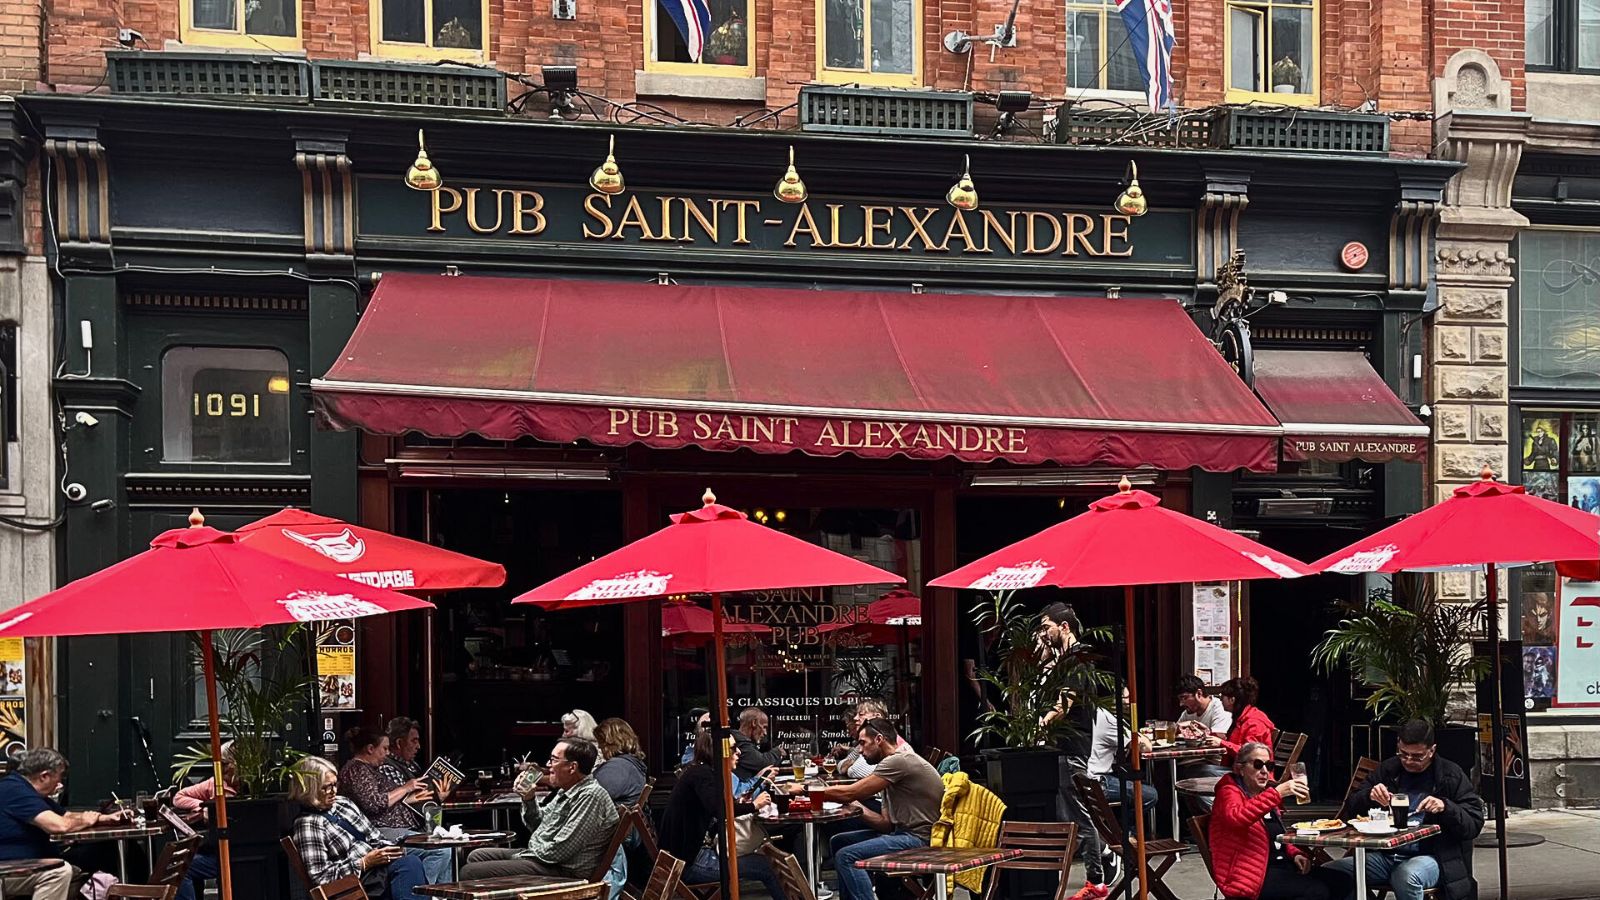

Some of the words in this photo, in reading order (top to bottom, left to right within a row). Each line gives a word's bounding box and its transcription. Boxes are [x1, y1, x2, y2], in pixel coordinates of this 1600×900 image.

[427, 187, 547, 234] PUB
[582, 193, 1133, 257] SAINT-ALEXANDRE
[194, 393, 259, 417] 1091
[607, 408, 679, 438] PUB
[693, 413, 798, 444] SAINT
[815, 420, 1029, 454] ALEXANDRE
[1296, 441, 1315, 451] PUB
[1319, 442, 1350, 452] SAINT
[1353, 443, 1416, 453] ALEXANDRE
[993, 573, 1037, 581] STELLA
[596, 582, 655, 591] STELLA
[591, 590, 647, 598] ARTOIS
[298, 600, 357, 612] STELLA
[310, 608, 369, 619] ARTOIS
[771, 626, 819, 645] PUB
[0, 701, 24, 709] RROS
[738, 697, 820, 708] CLASSIQUES
[824, 697, 842, 706] DU
[777, 731, 811, 739] Poisson
